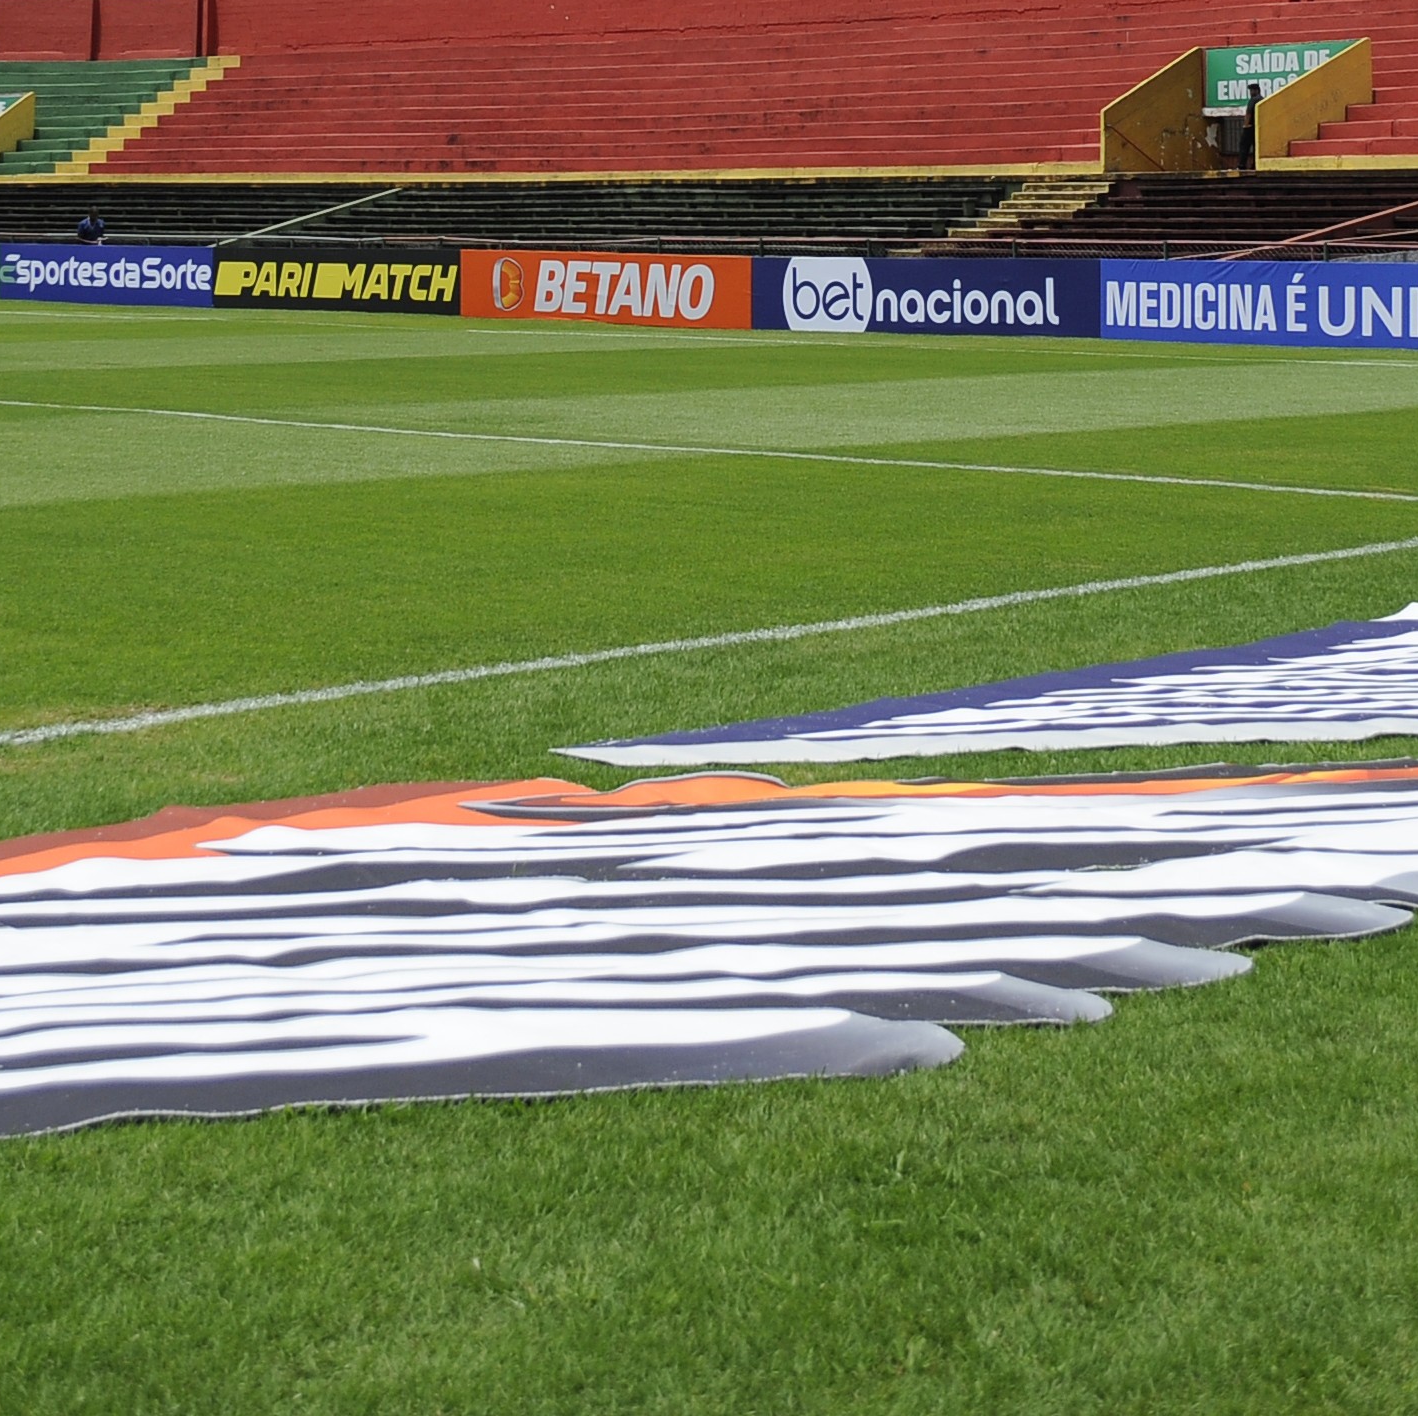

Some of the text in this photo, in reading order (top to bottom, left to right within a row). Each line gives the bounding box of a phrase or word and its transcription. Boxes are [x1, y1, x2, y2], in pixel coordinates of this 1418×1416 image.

[1236, 49, 1299, 74] SAÍDA
[534, 259, 715, 320] BETANO
[1105, 281, 1277, 332] MEDICINA
[1286, 273, 1307, 333] É
